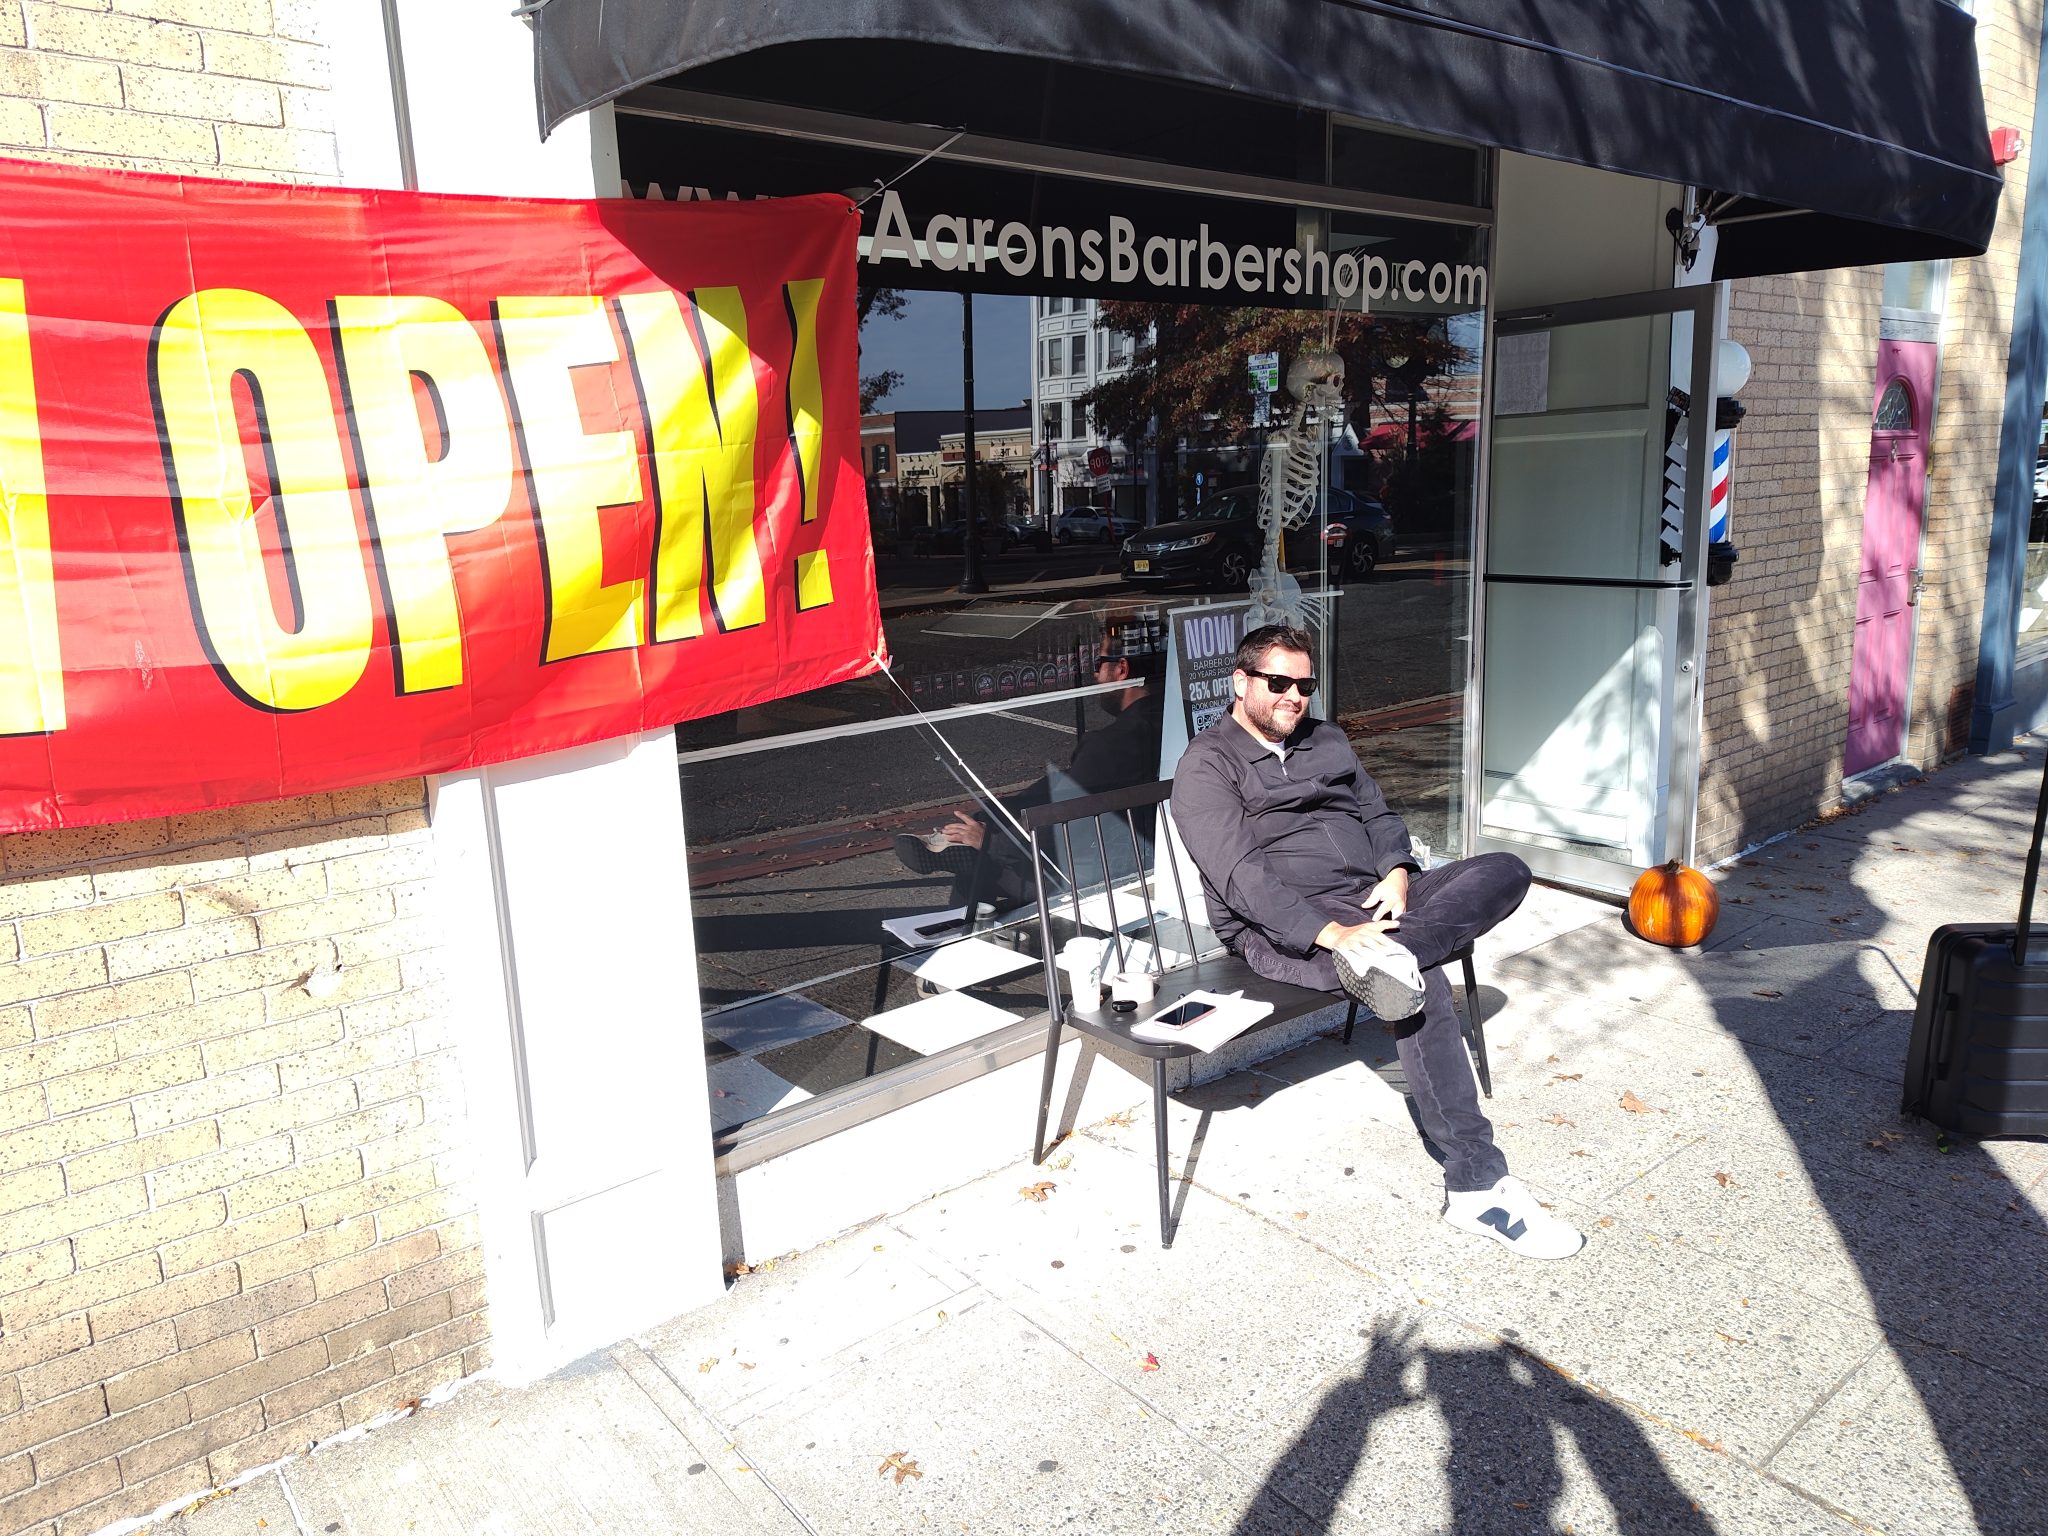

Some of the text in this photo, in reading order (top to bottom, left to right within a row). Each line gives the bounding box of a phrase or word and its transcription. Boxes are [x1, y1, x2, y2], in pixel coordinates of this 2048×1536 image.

[622, 179, 1487, 313] AaronsBarbershop.com
[147, 278, 834, 714] OPEN!
[1184, 614, 1235, 660] NOW
[1189, 672, 1197, 680] 20
[1197, 669, 1217, 679] YEARS
[1194, 658, 1223, 671] BARBER
[1189, 680, 1211, 702] 25%
[1191, 697, 1230, 711] BOOK ONLINE
